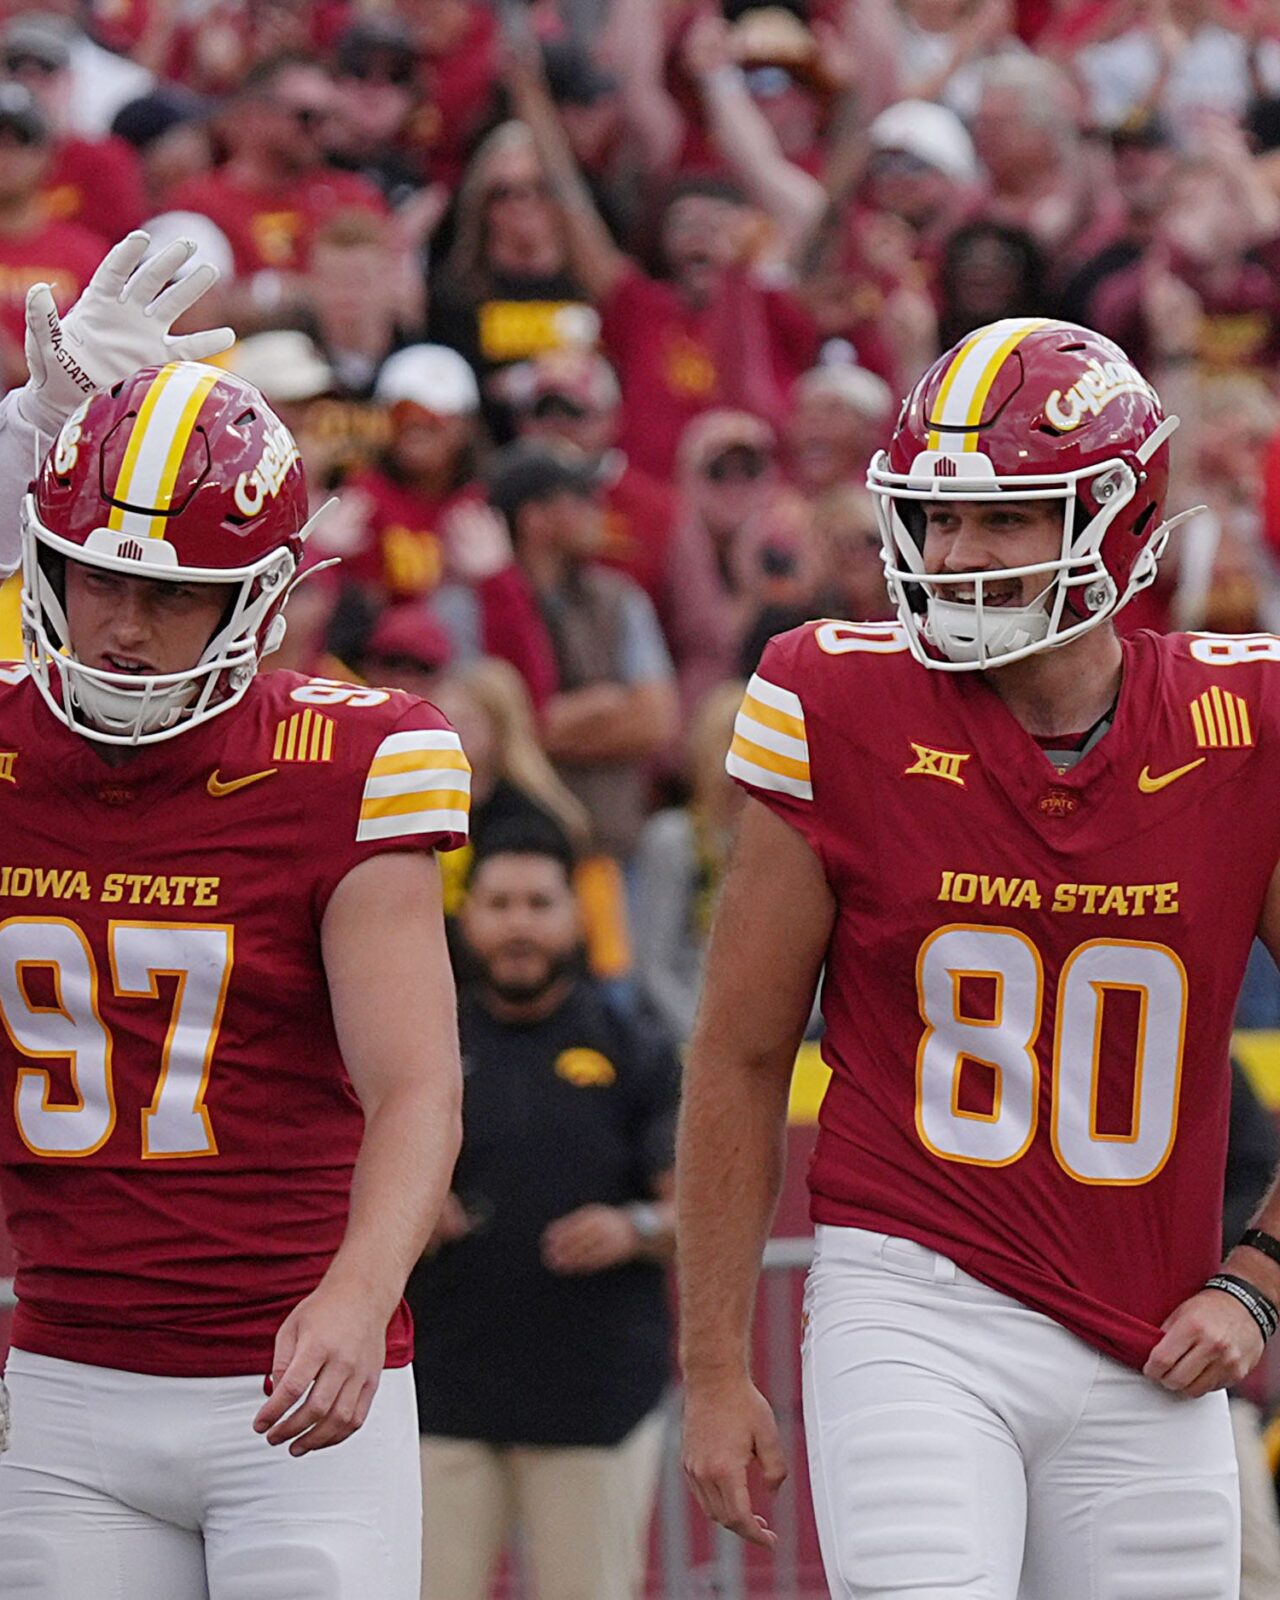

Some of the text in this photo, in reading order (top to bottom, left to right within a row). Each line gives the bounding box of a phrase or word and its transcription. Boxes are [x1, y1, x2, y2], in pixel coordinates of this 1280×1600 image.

[904, 742, 970, 786] XII
[100, 874, 220, 906] STATE
[937, 872, 1179, 916] IOWA STATE
[915, 923, 1188, 1186] 80
